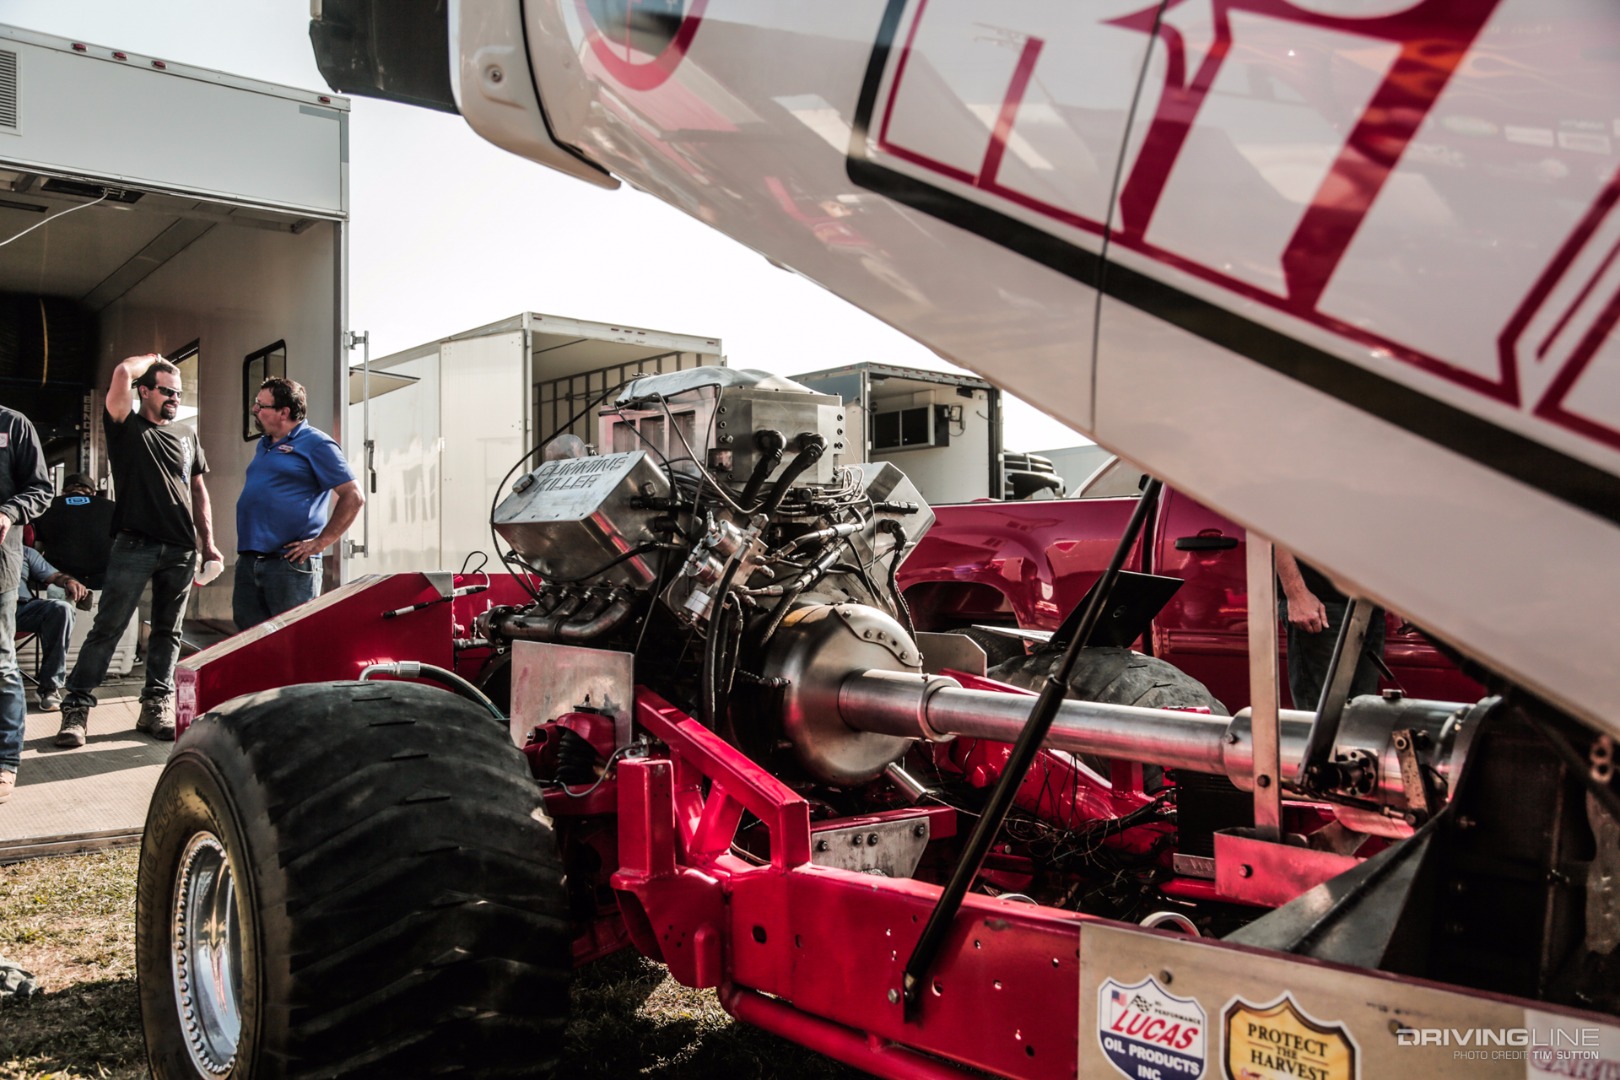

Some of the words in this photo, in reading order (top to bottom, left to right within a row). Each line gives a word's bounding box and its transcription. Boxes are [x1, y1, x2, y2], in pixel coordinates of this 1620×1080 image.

[537, 456, 628, 478] CUMMINS
[533, 474, 601, 492] KILLER
[1110, 1009, 1199, 1050] LUCAS
[1248, 1023, 1328, 1057] PROTECT
[1104, 1037, 1126, 1054] OIL
[1128, 1045, 1200, 1076] PRODUCTS
[1251, 1049, 1330, 1080] HARVEST
[1276, 1046, 1298, 1060] THE
[1137, 1064, 1162, 1080] INC
